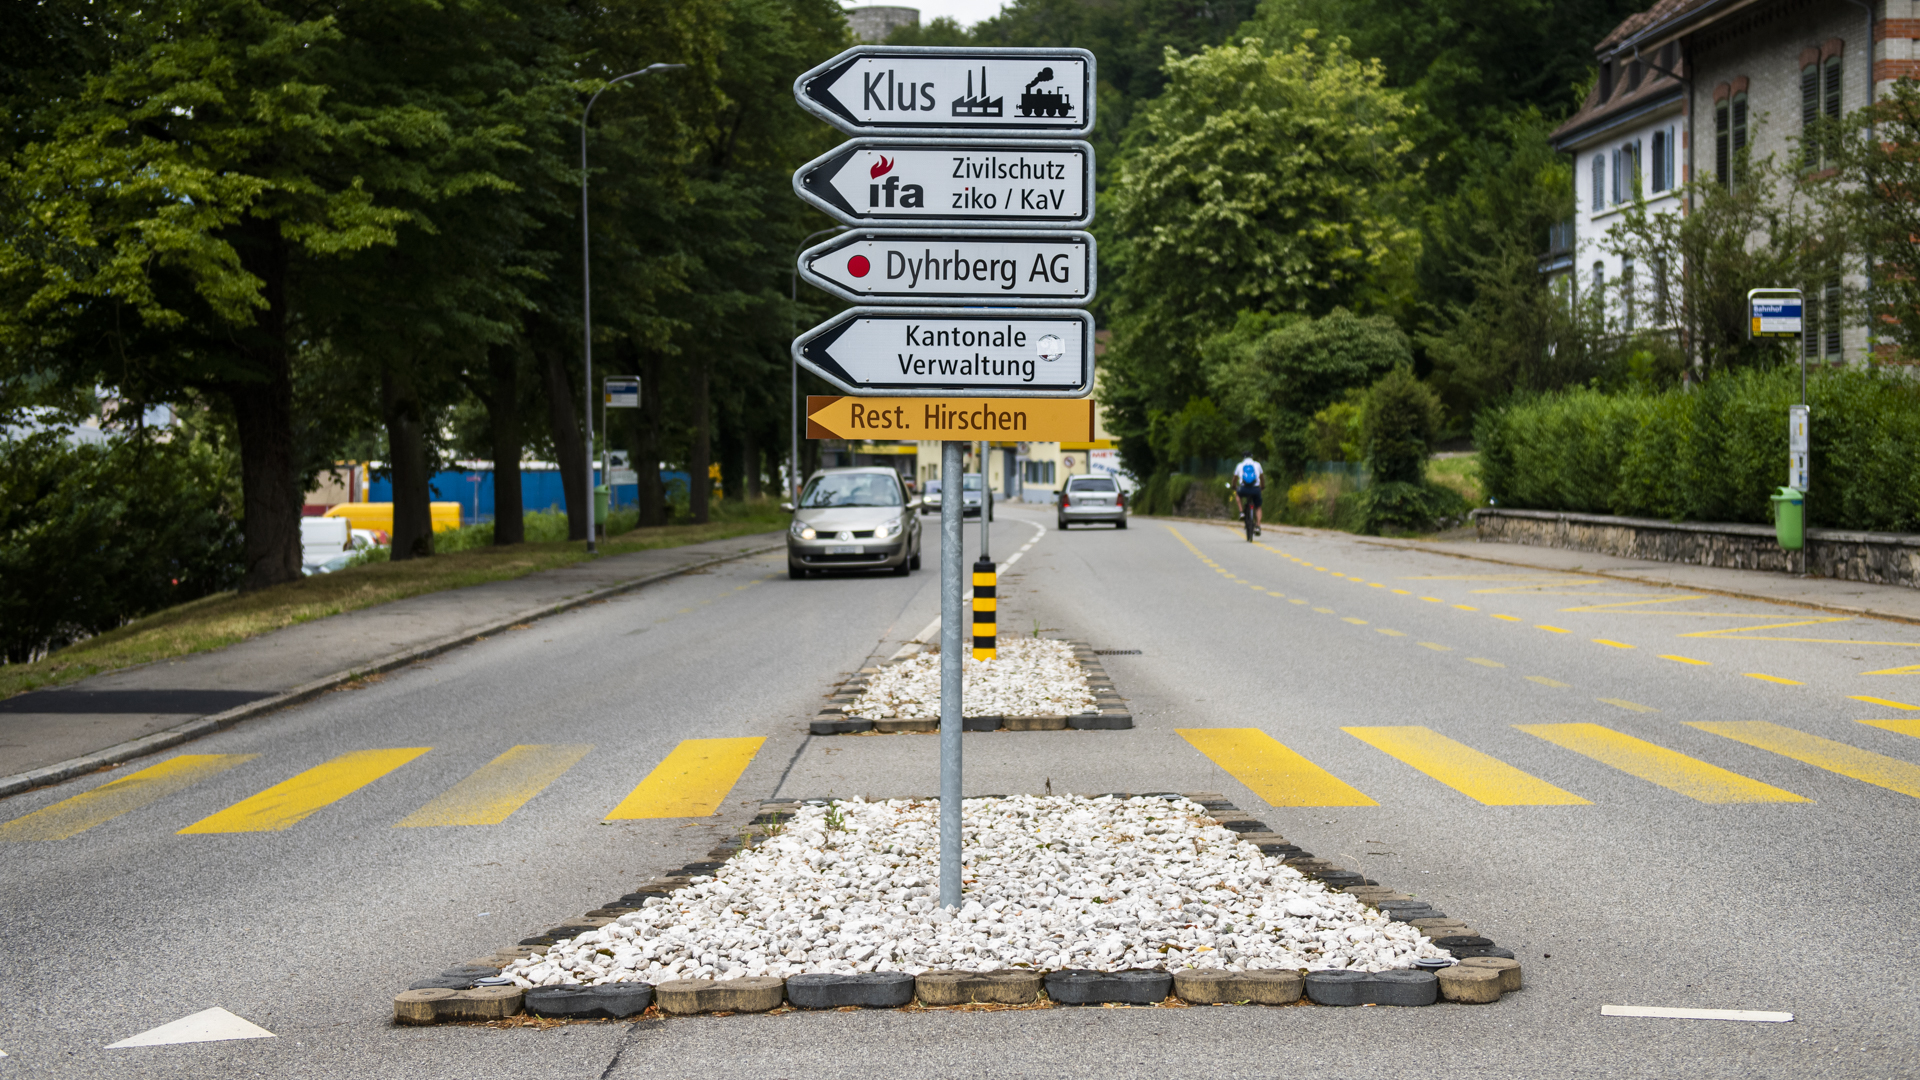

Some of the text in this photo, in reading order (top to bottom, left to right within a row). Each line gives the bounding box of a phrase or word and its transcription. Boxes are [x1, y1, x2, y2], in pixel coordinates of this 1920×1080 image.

[863, 70, 936, 111] Klus
[952, 157, 1065, 180] Zivilschutz
[869, 176, 924, 208] ifa
[952, 187, 1065, 210] ziko / KaV
[887, 249, 1070, 290] Dyhrberg AG
[906, 325, 1027, 347] Kantonale
[898, 353, 1036, 382] Verwaltung
[851, 403, 1028, 431] Rest. Hirschen
